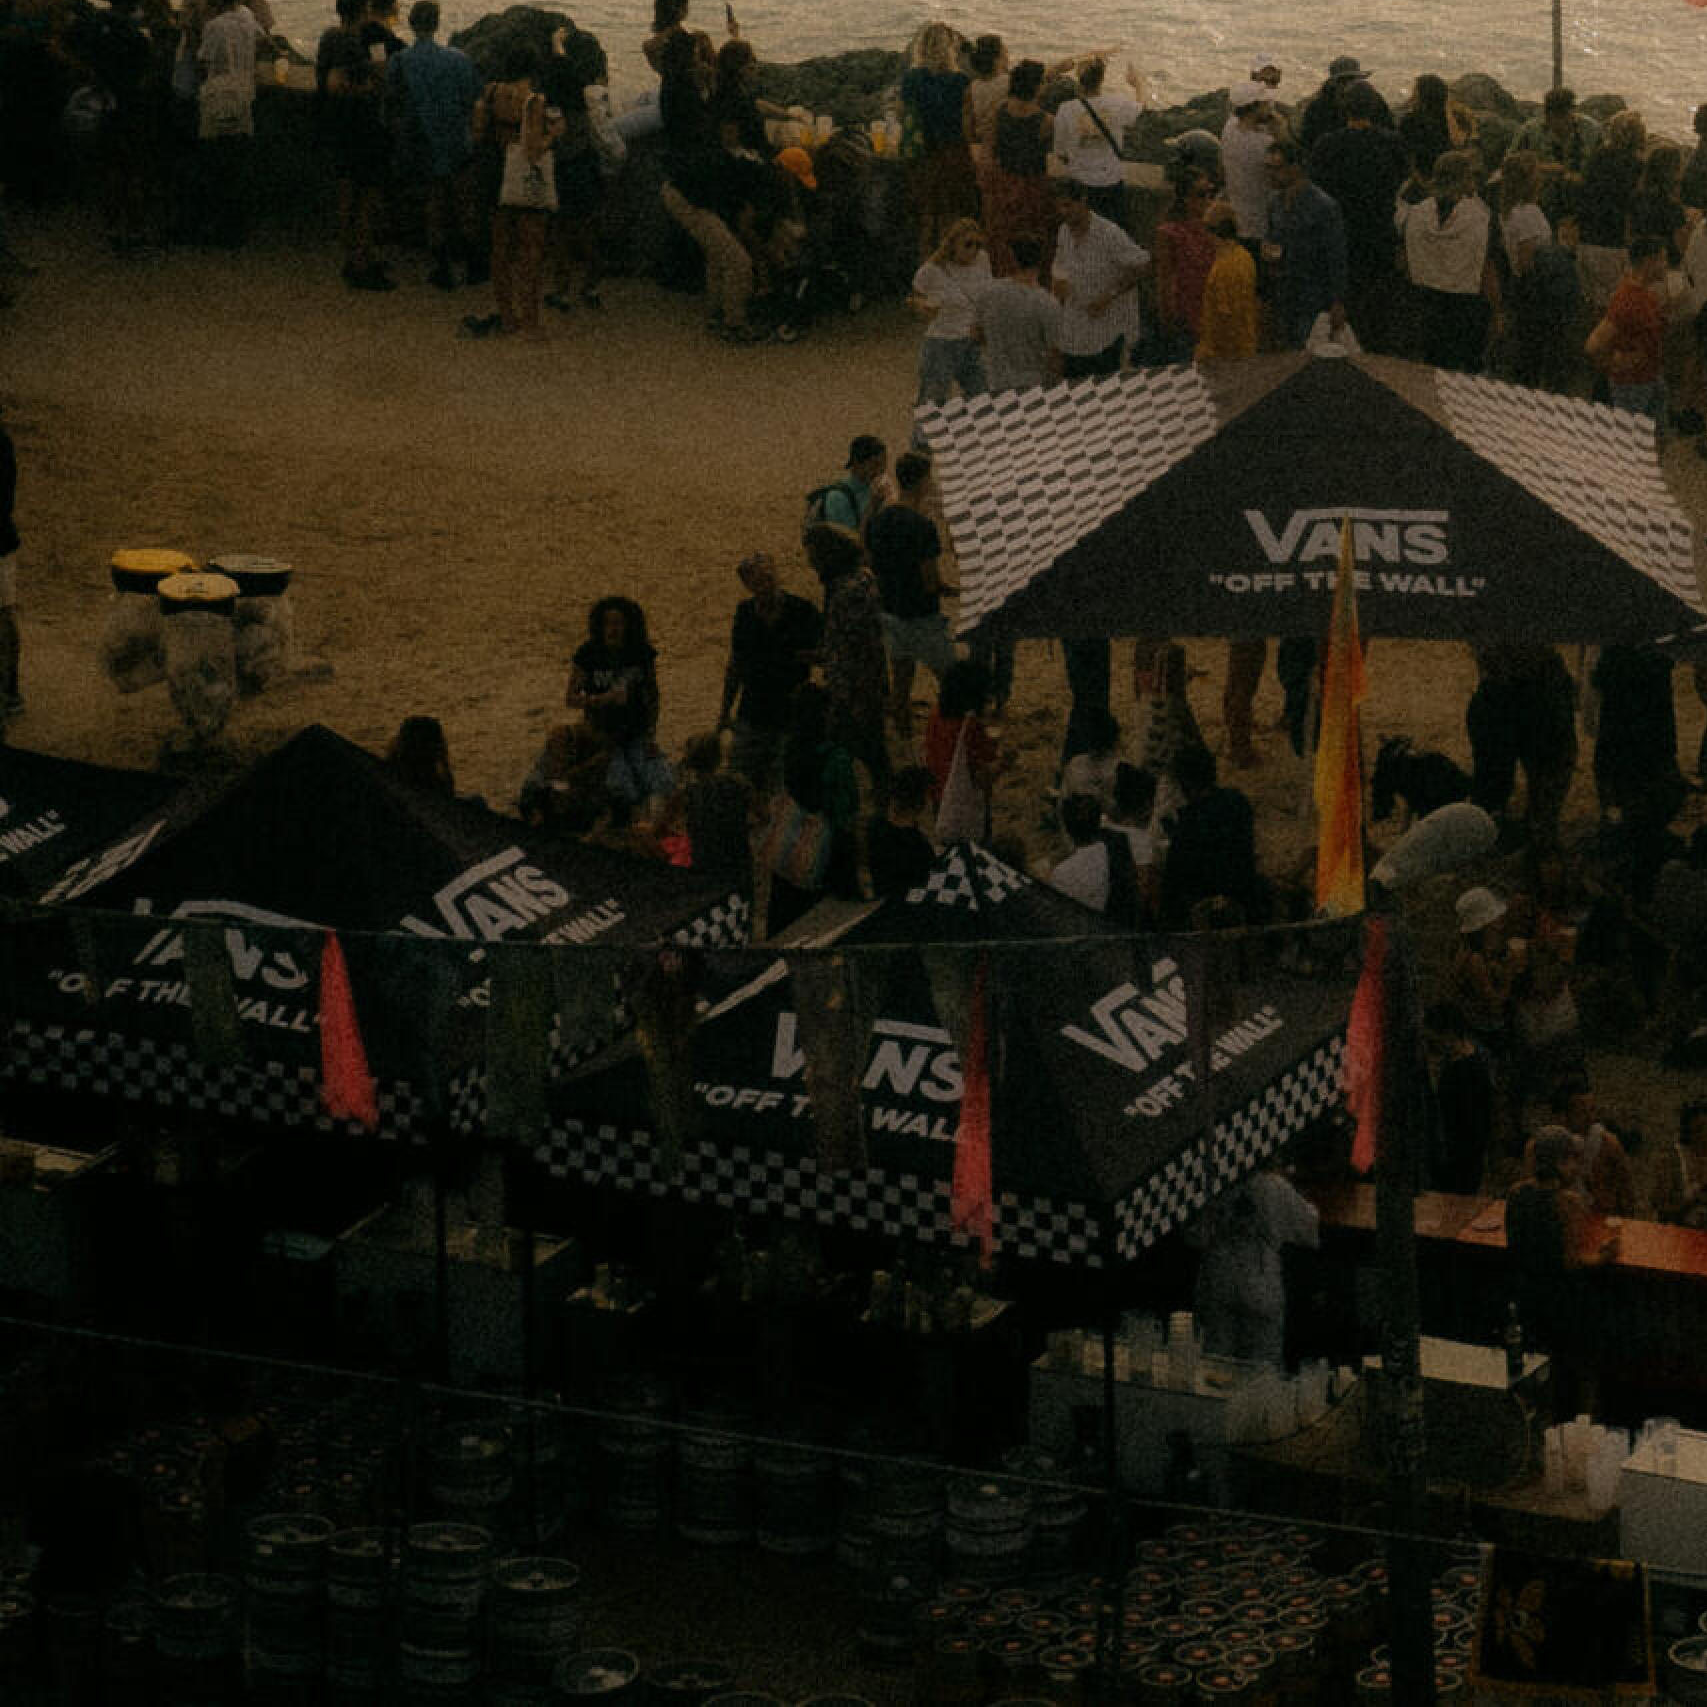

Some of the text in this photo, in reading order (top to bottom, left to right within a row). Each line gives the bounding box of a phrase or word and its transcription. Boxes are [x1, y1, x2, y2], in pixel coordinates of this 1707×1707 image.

[1243, 507, 1450, 565] VANS
[1209, 572, 1296, 593] "OFF
[1379, 572, 1486, 598] WALL"
[401, 845, 570, 962] VANS
[48, 970, 136, 998] "OF
[771, 1012, 966, 1104] VNS
[693, 1081, 785, 1114] "OFF
[1122, 1075, 1185, 1117] "OFF
